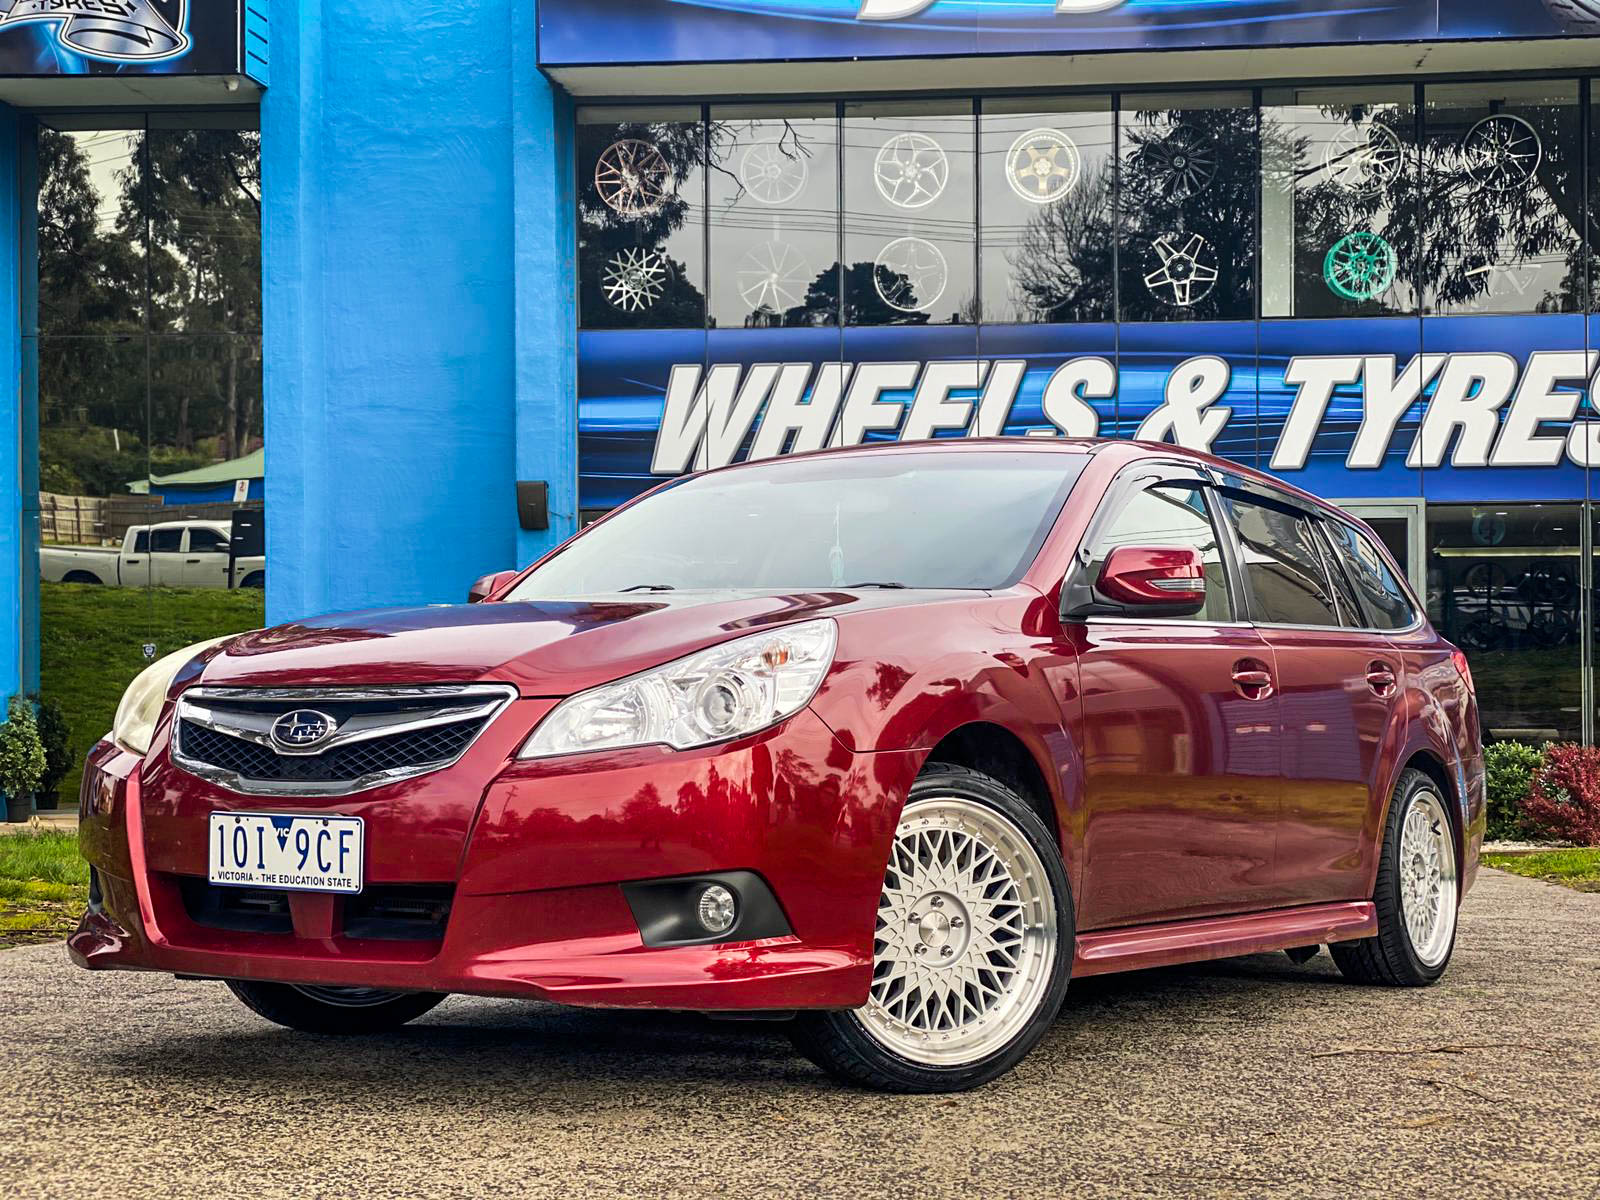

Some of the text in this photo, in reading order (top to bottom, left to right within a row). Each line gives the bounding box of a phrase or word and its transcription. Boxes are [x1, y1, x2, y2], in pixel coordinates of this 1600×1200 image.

[1133, 355, 1231, 454] &
[274, 827, 290, 838] VIC
[295, 828, 353, 874] 9CF
[217, 871, 254, 882] VICTORIA
[261, 873, 276, 883] THE
[279, 875, 325, 886] EDUCATION
[327, 877, 351, 888] STATE
